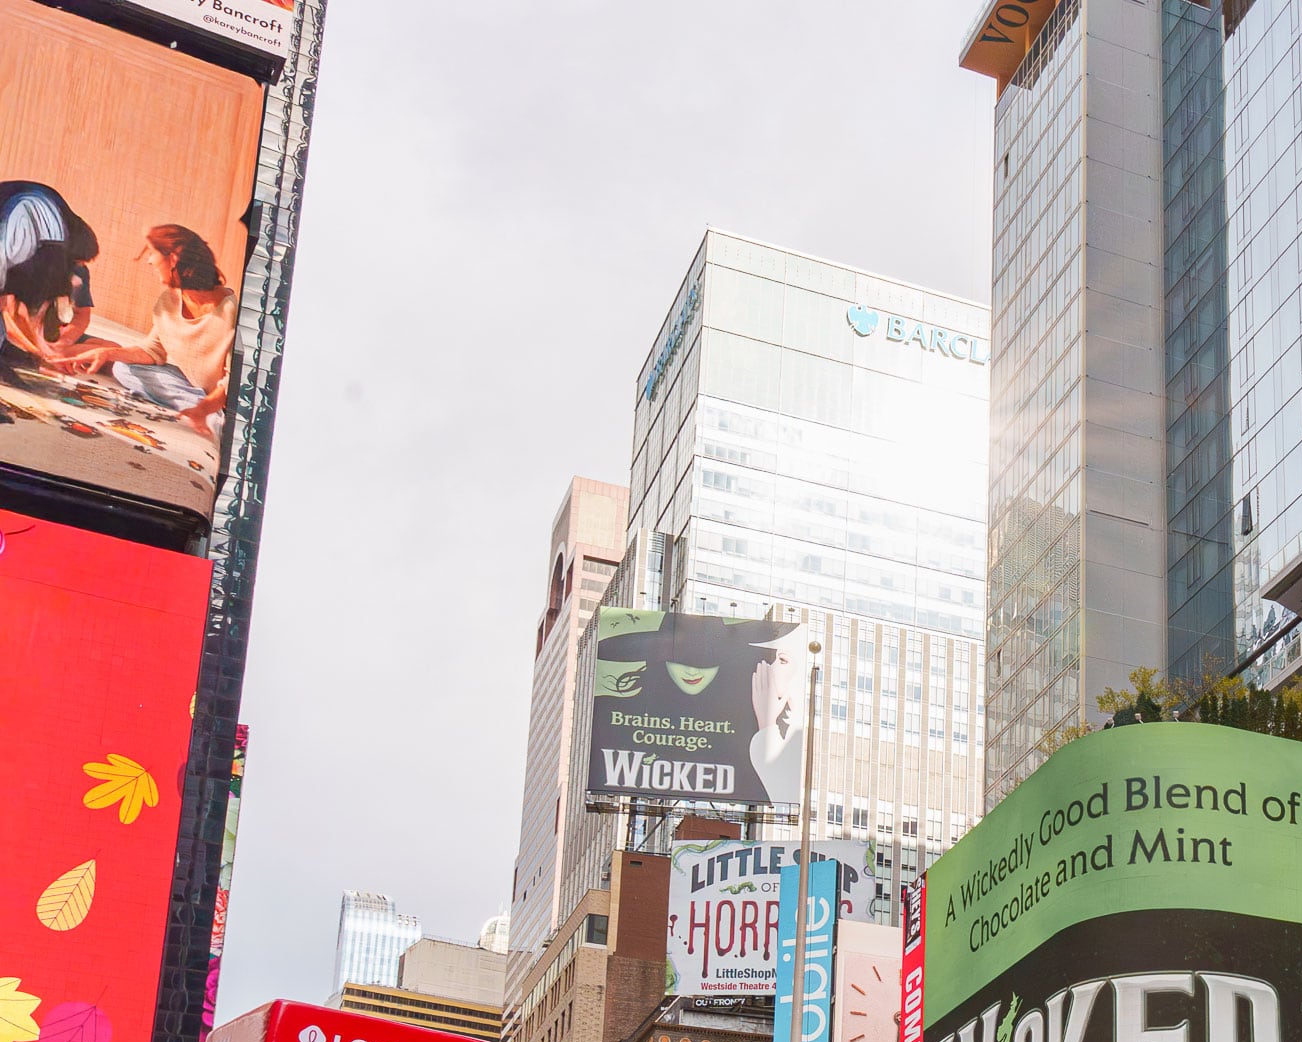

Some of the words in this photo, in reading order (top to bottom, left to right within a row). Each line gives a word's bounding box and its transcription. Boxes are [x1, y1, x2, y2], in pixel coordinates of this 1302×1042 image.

[202, 14, 282, 48] @kareybancroft
[886, 314, 991, 365] BARCL
[611, 711, 675, 731] Brains.
[679, 716, 736, 735] Heart.
[632, 730, 713, 751] Courage.
[691, 846, 785, 894] LITTLE
[945, 894, 956, 927] A
[960, 832, 1035, 912] Wickedly
[1039, 782, 1109, 846] Good
[1124, 775, 1248, 817] Blend
[1261, 791, 1301, 826] of
[969, 870, 1051, 953] Chocolate
[1055, 830, 1117, 888] and
[1127, 827, 1234, 867] Mint
[700, 982, 737, 991] Westside
[739, 982, 770, 991] Theatre
